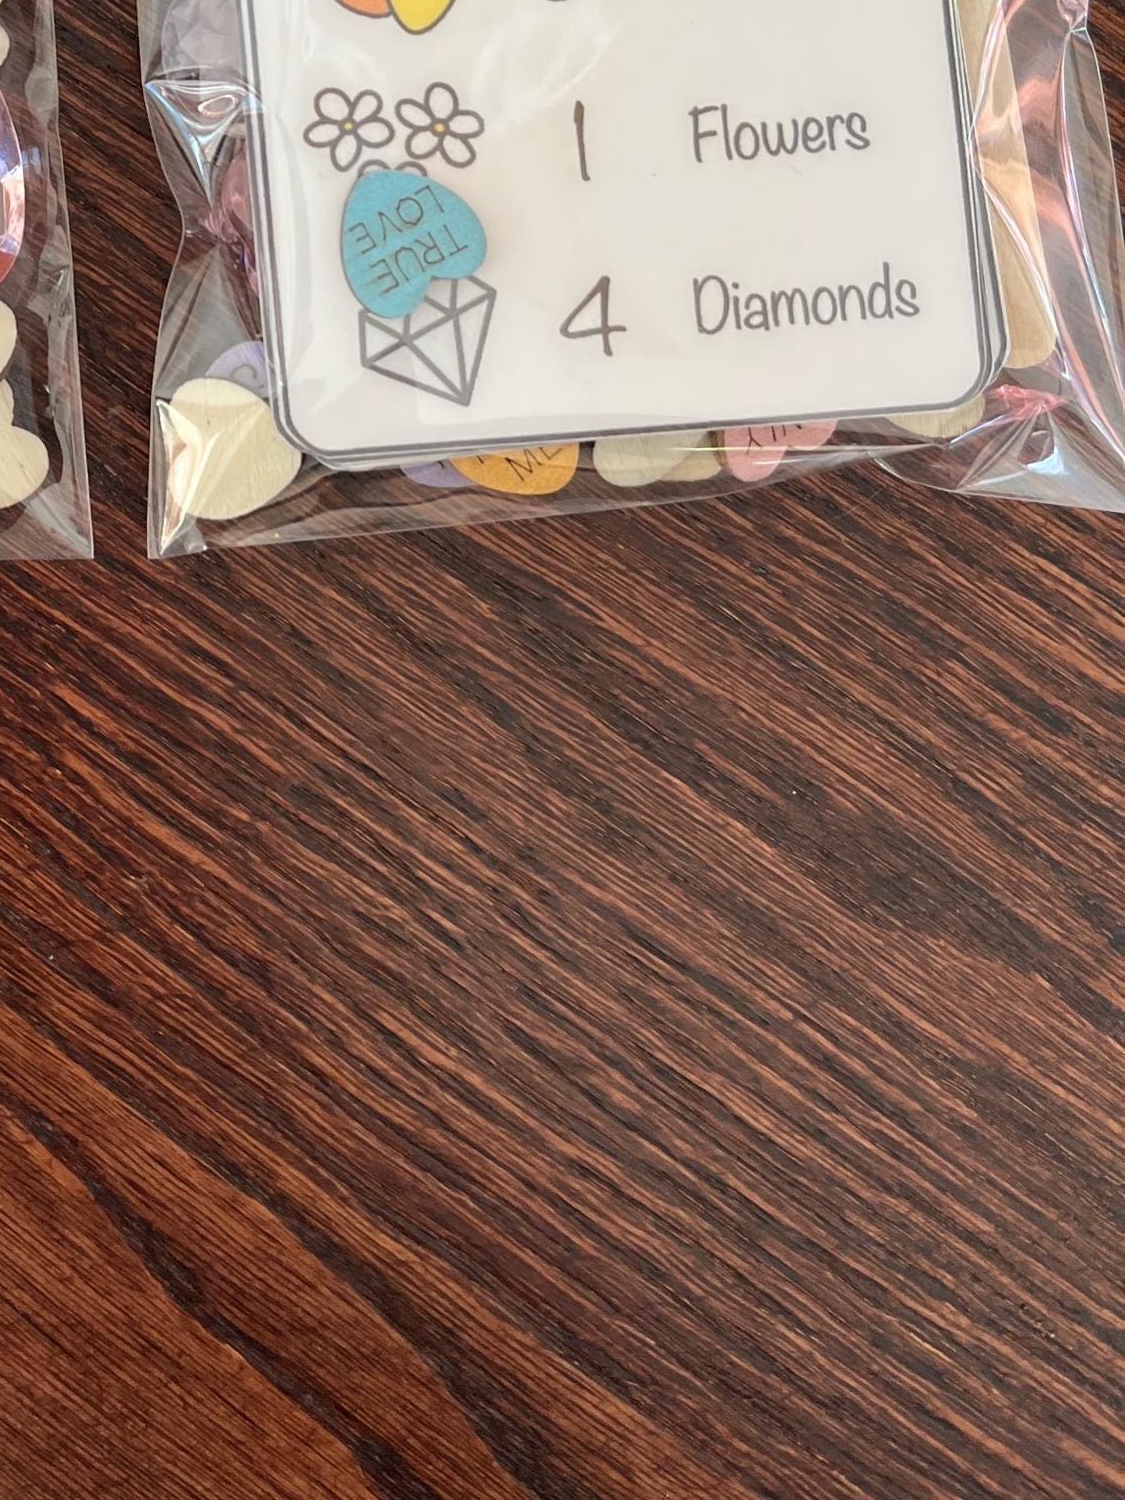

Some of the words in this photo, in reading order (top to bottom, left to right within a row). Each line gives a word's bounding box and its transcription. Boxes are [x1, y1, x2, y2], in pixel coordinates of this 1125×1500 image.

[574, 100, 591, 181] 1
[688, 104, 870, 163] Flowers
[348, 184, 445, 254] LOVE
[369, 223, 469, 296] TRUE
[559, 275, 627, 356] 4
[692, 262, 919, 334] Diamonds
